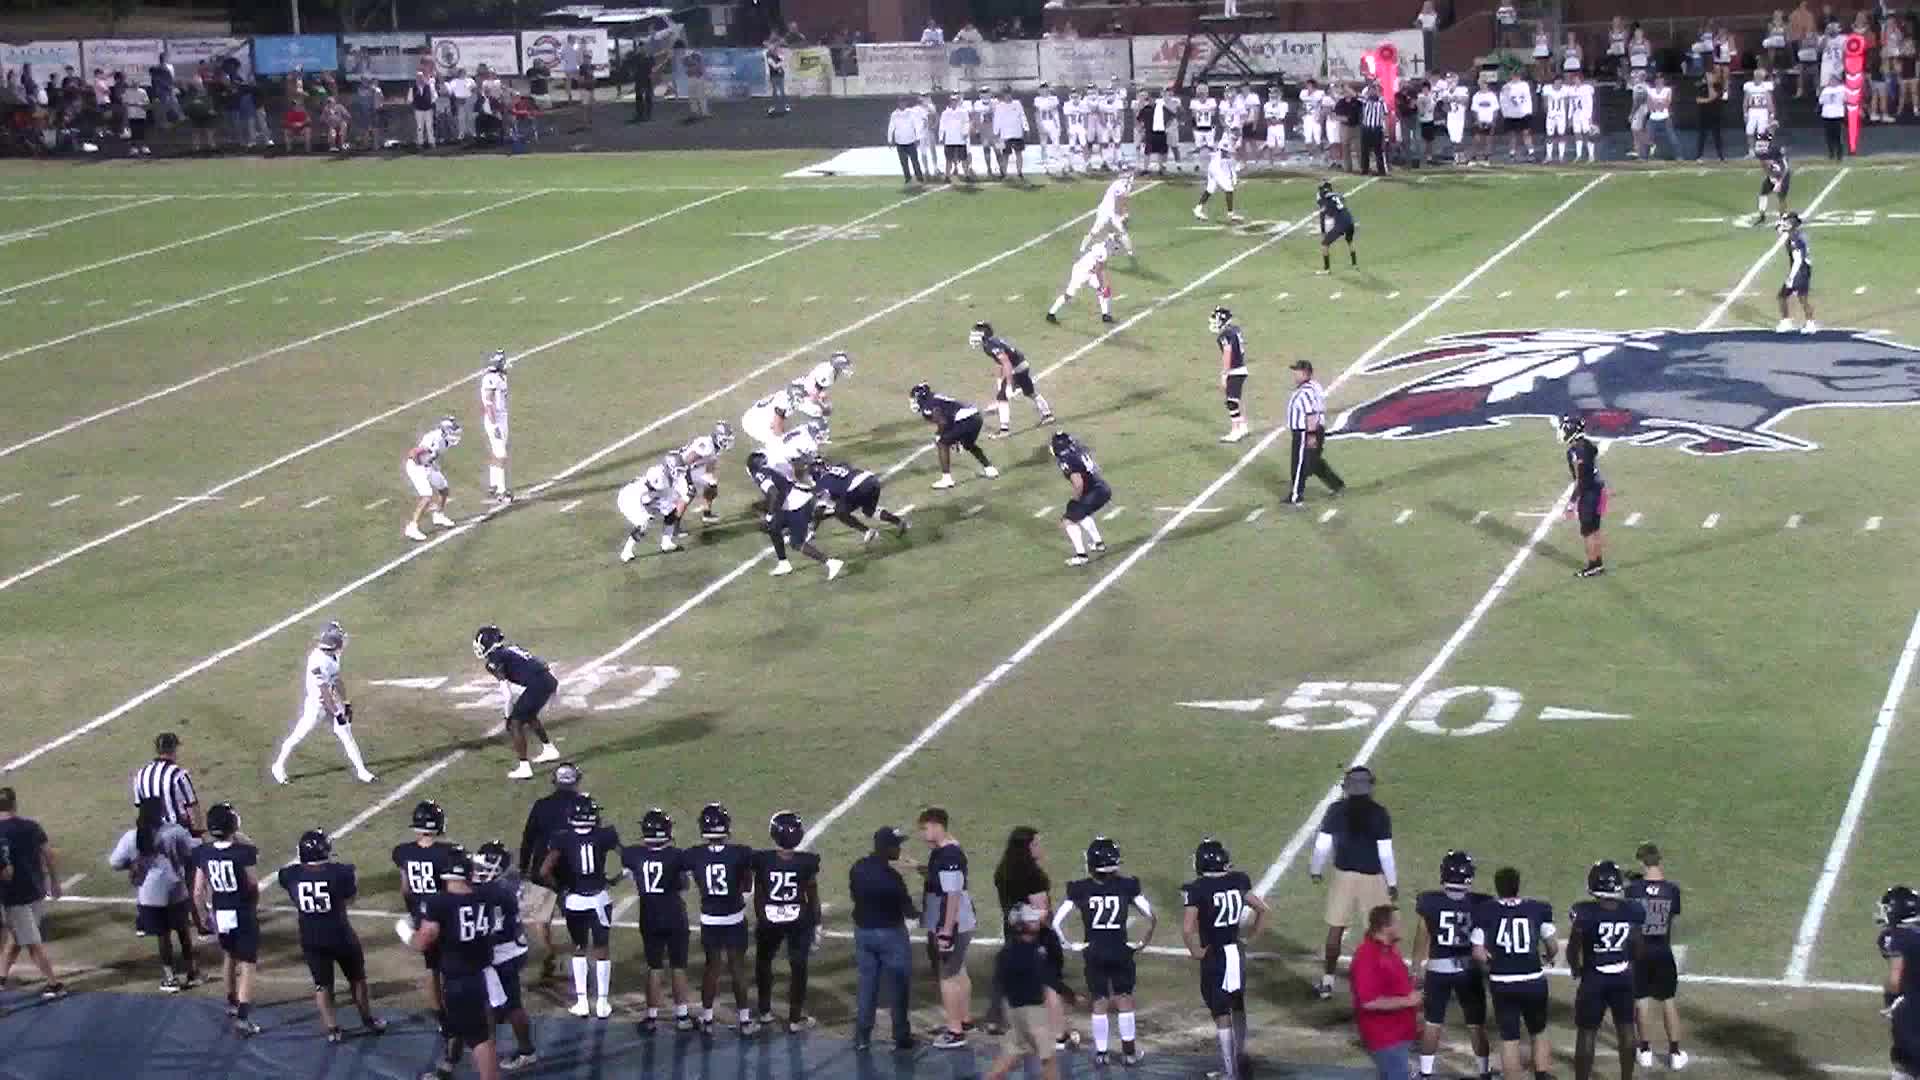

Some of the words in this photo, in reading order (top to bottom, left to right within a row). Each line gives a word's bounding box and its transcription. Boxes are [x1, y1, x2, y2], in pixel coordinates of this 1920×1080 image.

[1268, 683, 1522, 737] 50
[580, 844, 594, 874] 11
[208, 860, 237, 892] 80
[408, 861, 436, 893] 68
[643, 860, 664, 893] 12
[705, 864, 728, 895] 13
[770, 872, 797, 901] 25
[298, 881, 331, 912] 65
[1089, 896, 1121, 929] 22
[1213, 890, 1242, 927] 20
[459, 902, 489, 941] 64
[1496, 918, 1530, 954] 40
[1598, 922, 1630, 952] 32
